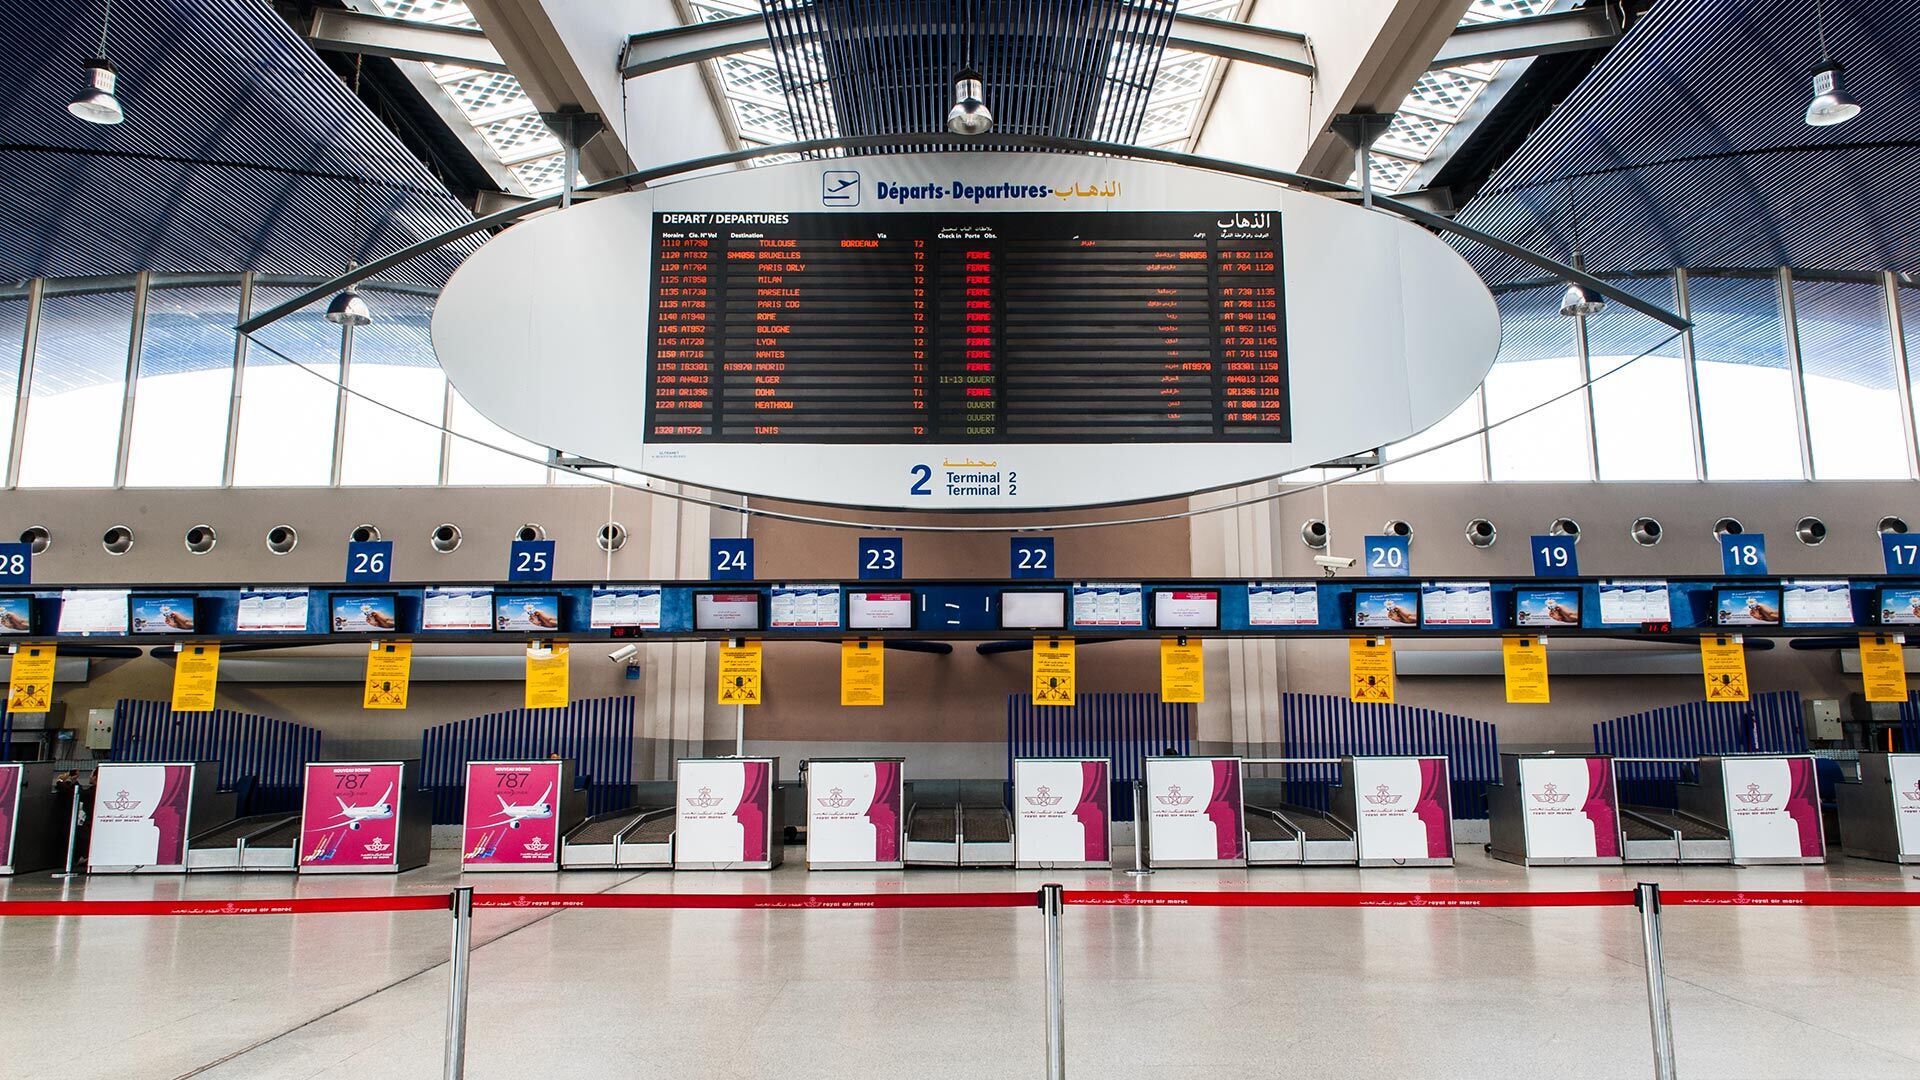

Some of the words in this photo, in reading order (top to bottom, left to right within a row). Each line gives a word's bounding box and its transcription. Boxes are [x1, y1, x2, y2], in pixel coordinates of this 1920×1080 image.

[662, 214, 707, 224] DEPART
[715, 214, 789, 224] DEPARTURES
[1217, 213, 1271, 233] الذهاب
[661, 239, 681, 247] 1110
[759, 239, 797, 247] TOULOUSE
[840, 239, 879, 247] BORDEAUX
[913, 240, 925, 248] T2
[661, 251, 681, 259] 1120
[758, 251, 801, 259] BRUXELLES
[913, 251, 925, 259] T2
[966, 251, 991, 259] FERME
[660, 263, 680, 271] 1120
[758, 263, 783, 271] PARIS
[785, 263, 806, 271] ORLY
[913, 264, 925, 272] T2
[966, 263, 991, 271] FERME
[660, 275, 680, 283] 1125
[757, 275, 783, 283] MILAN
[913, 276, 925, 284] T2
[966, 275, 991, 283] FERME
[659, 288, 679, 296] 1135
[757, 288, 801, 296] MARSEILLE
[913, 288, 925, 296] T2
[966, 288, 991, 296] FERME
[659, 300, 679, 308] 1135
[757, 300, 782, 308] PARIS
[785, 300, 801, 308] CDG
[913, 301, 925, 309] T2
[966, 300, 991, 308] FERME
[658, 312, 678, 320] 1140
[756, 312, 777, 320] ROME
[913, 313, 925, 321] T2
[966, 312, 991, 320] FERME
[658, 325, 678, 333] 1145
[756, 325, 791, 333] BOLOGNE
[913, 325, 925, 333] T2
[966, 325, 991, 333] FERME
[657, 337, 677, 345] 1145
[756, 337, 777, 345] LYON
[913, 338, 925, 346] T2
[966, 337, 991, 345] FERME
[657, 350, 677, 358] 1150
[755, 350, 785, 358] NANTES
[913, 351, 925, 359] T2
[966, 350, 991, 358] FERME
[656, 362, 676, 370] 1150
[755, 362, 785, 370] MADRID
[913, 363, 924, 371] T1
[966, 362, 991, 370] FERME
[656, 375, 676, 383] 1200
[754, 375, 780, 383] ALGER
[913, 375, 924, 383] T1
[939, 375, 964, 383] 11-13
[966, 375, 996, 383] OUVERT
[655, 387, 676, 395] 1210
[754, 387, 776, 395] DOHA
[913, 388, 924, 396] T1
[966, 387, 991, 395] FERME
[655, 400, 676, 408] 1220
[754, 400, 794, 408] HEATHROW
[913, 401, 925, 409] T2
[966, 400, 996, 408] OUVERT
[966, 413, 996, 421] OUVERT
[654, 426, 675, 434] 1320
[754, 426, 780, 434] TUNIS
[913, 426, 925, 434] T2
[966, 426, 996, 434] OUVERT
[910, 464, 932, 496] 2
[946, 471, 1000, 483] Terminal
[1008, 471, 1017, 483] 2
[946, 484, 1000, 496] Terminal
[1008, 484, 1017, 496] 2
[1018, 548, 1047, 569] 22
[1372, 547, 1402, 567] 20
[1541, 547, 1568, 567] 19
[1730, 545, 1758, 566] 18
[1892, 545, 1918, 565] 17
[354, 552, 384, 573] 26
[516, 552, 547, 572] 25
[717, 550, 747, 571] 24
[866, 549, 895, 570] 23
[0, 554, 25, 575] 28
[335, 773, 369, 789] 787
[496, 772, 529, 788] 787
